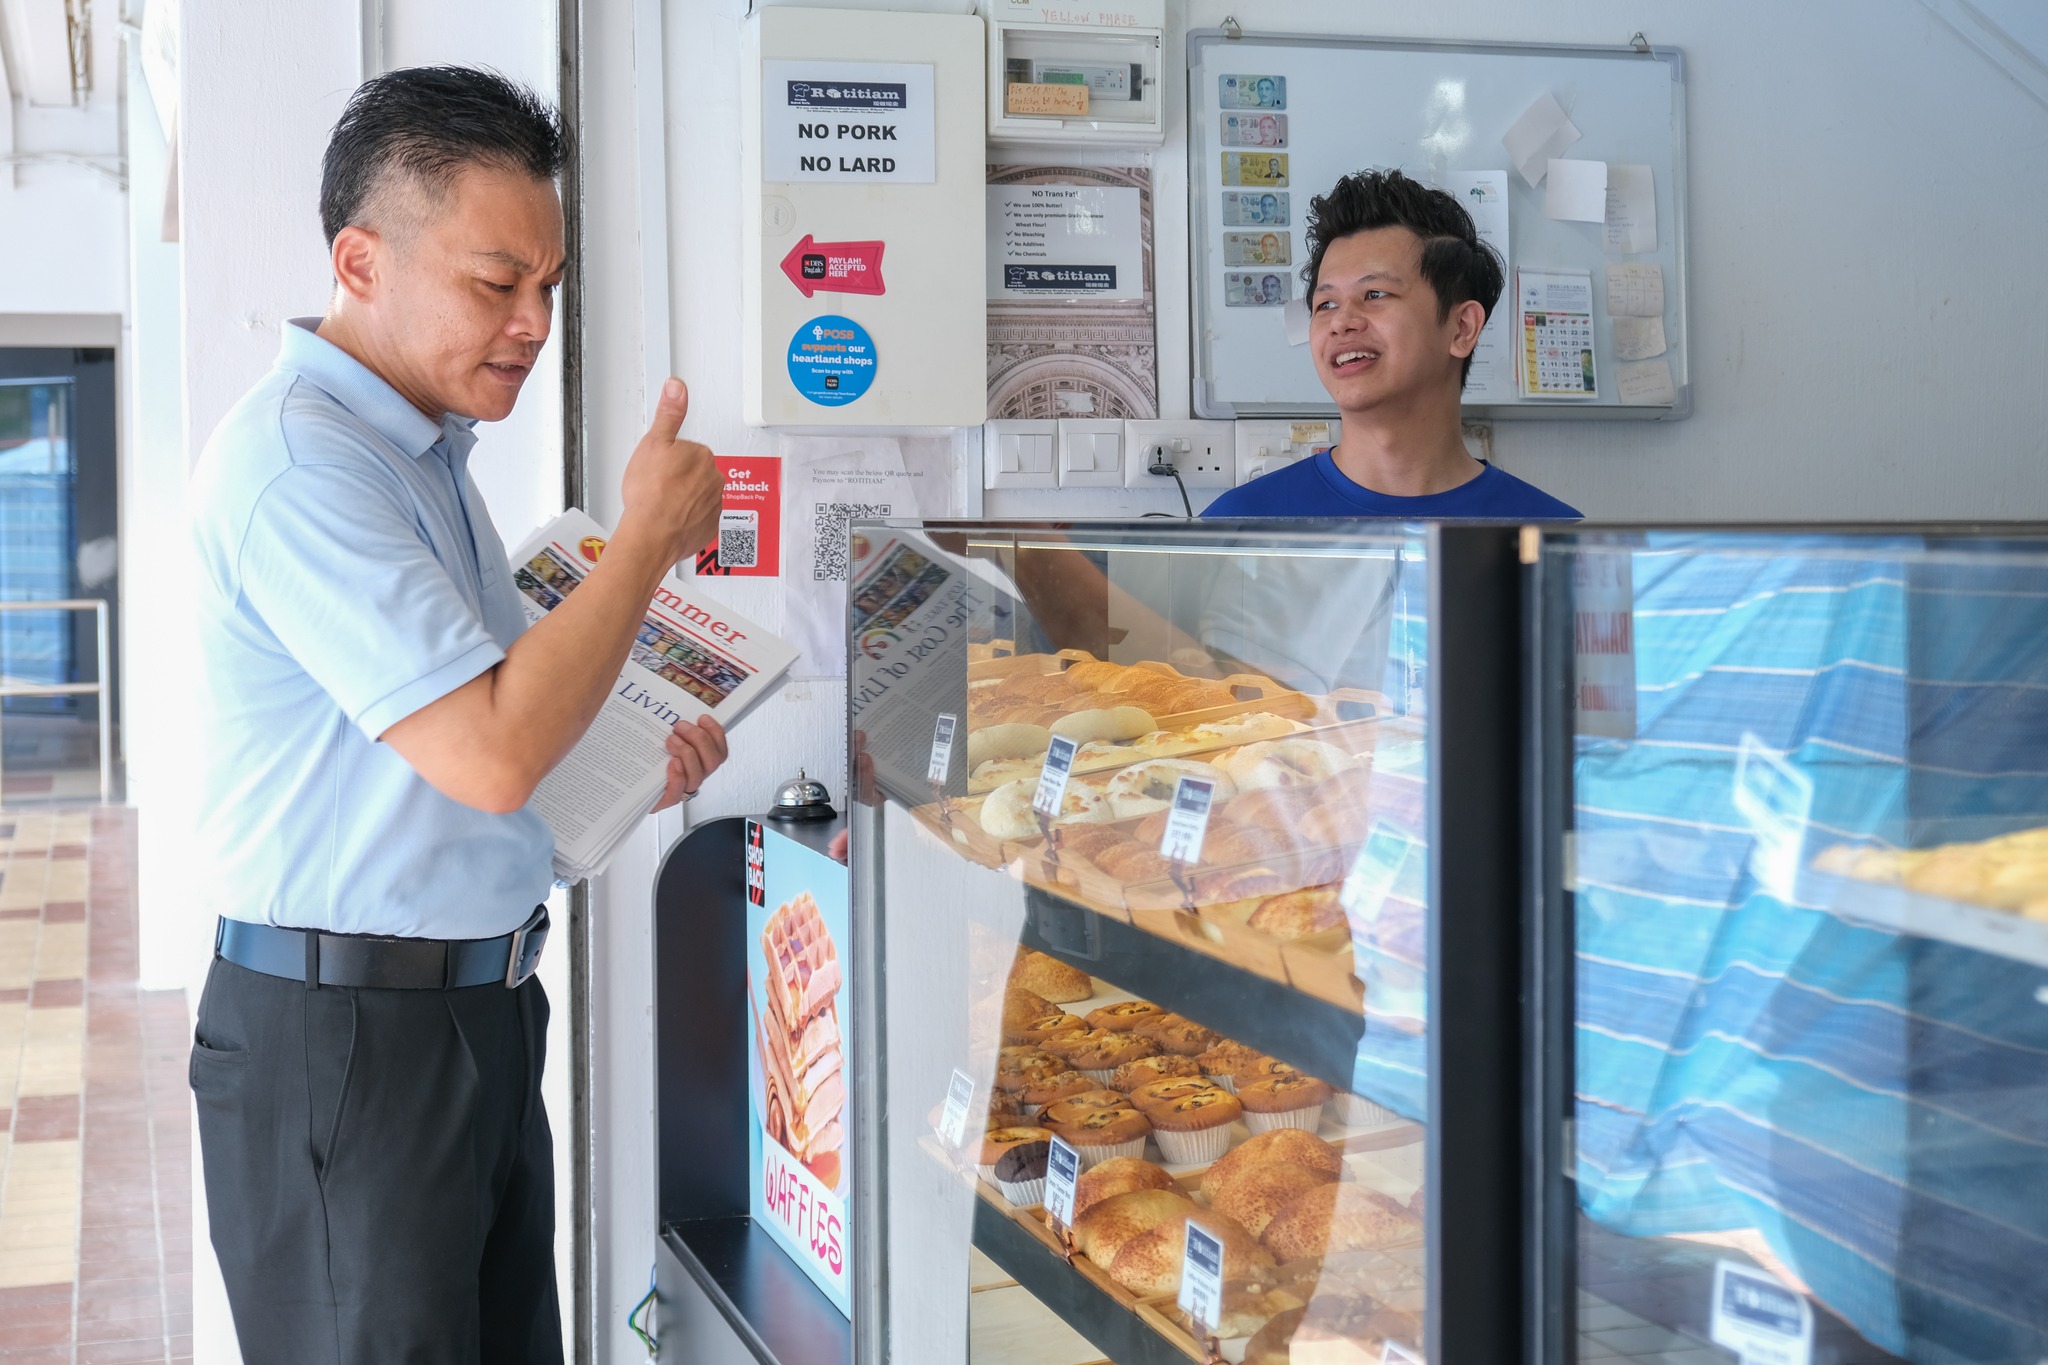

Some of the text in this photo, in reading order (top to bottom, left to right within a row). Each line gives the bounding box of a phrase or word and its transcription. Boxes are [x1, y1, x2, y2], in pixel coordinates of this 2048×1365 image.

[1099, 13, 1139, 26] PHASE
[798, 123, 898, 141] NO PORK
[800, 156, 896, 173] NO LARD
[1045, 190, 1064, 198] Trans
[828, 257, 862, 265] PAYLAH!
[823, 329, 855, 340] POSB
[802, 343, 866, 353] supports our
[792, 354, 873, 367] heartland shops
[728, 468, 751, 479] Get
[812, 468, 826, 476] You
[723, 481, 769, 492] shback
[653, 586, 747, 644] mmer
[618, 681, 681, 728] Livin
[748, 843, 764, 867] SHOP
[748, 866, 765, 891] BACK
[765, 1154, 842, 1276] WAFFLES
